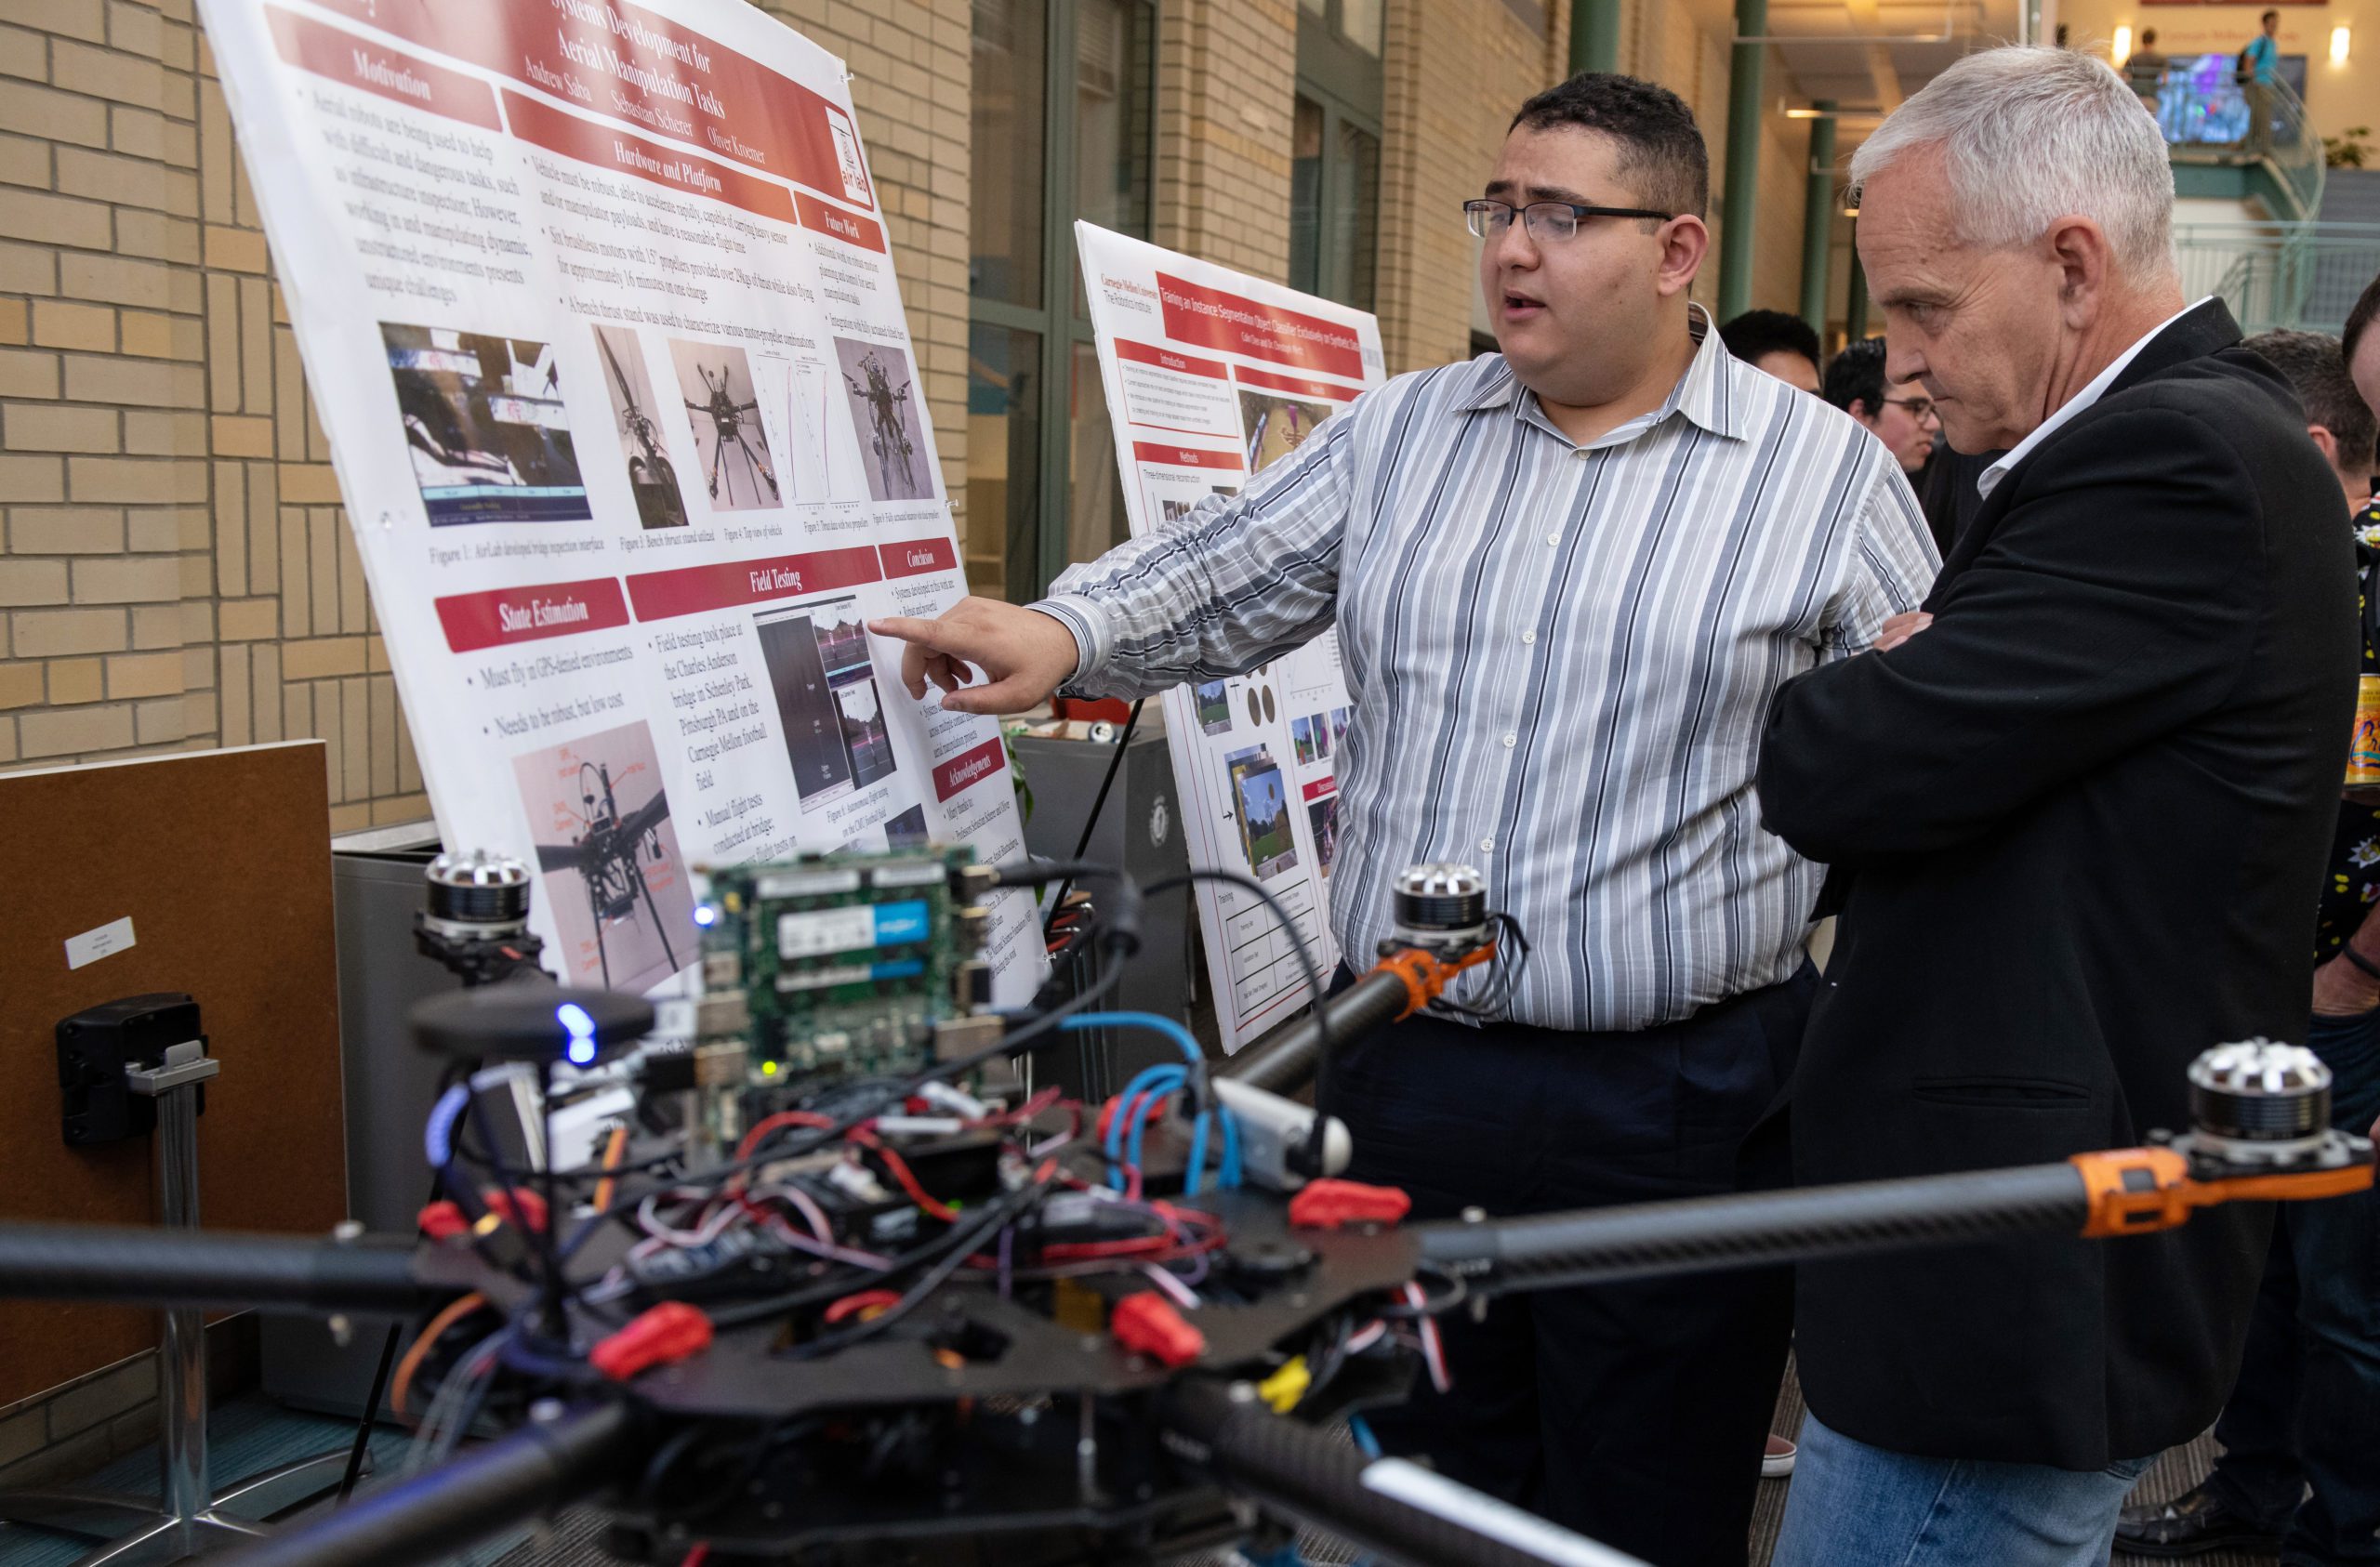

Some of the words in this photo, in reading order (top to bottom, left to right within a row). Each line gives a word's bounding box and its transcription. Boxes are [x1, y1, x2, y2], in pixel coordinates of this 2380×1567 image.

[605, 5, 693, 64] Development
[693, 44, 711, 73] for
[352, 48, 431, 100] Motivation
[558, 28, 604, 72] Aerial
[603, 46, 694, 106] Manipulation
[692, 82, 726, 119] Tasks
[525, 55, 563, 90] Andrew
[564, 73, 592, 101] Saba
[610, 89, 654, 125] Sebastian
[654, 108, 694, 137] Scherer
[707, 125, 732, 152] Oliver
[731, 135, 765, 165] Kroemer
[614, 140, 661, 176] Hardware
[663, 161, 681, 182] and
[682, 163, 722, 193] Platform
[842, 168, 854, 186] air
[854, 171, 866, 193] lab
[578, 172, 591, 191] be
[619, 183, 637, 202] able
[636, 189, 645, 204] to
[703, 209, 727, 228] capable
[727, 214, 734, 229] of
[825, 210, 845, 235] Future
[843, 218, 860, 239] Work
[599, 243, 627, 260] motors
[628, 245, 646, 264] with
[689, 260, 721, 280] provided
[721, 269, 734, 283] over
[623, 269, 635, 288] 16
[623, 306, 644, 323] stand
[643, 311, 660, 325] was
[1160, 287, 1183, 310] Training
[1183, 297, 1192, 310] an
[1192, 297, 1219, 317] Instance
[1218, 304, 1254, 325] Segmentation
[1159, 352, 1186, 369] Introduction
[1179, 451, 1199, 464] Methods
[619, 536, 640, 554] Figure
[723, 527, 738, 544] Figure
[743, 526, 753, 542] Top
[751, 526, 763, 538] view
[768, 523, 783, 536] vehicle
[906, 548, 935, 569] Conclusion
[749, 569, 772, 593] Field
[772, 566, 803, 591] Testing
[894, 586, 912, 602] Systems
[911, 580, 931, 599] developed
[498, 601, 533, 632] State
[532, 596, 588, 627] Estimation
[903, 604, 917, 617] Robust
[921, 599, 938, 618] powerful
[654, 632, 678, 653] Field
[677, 628, 705, 649] testing
[703, 624, 720, 643] took
[719, 623, 736, 645] place
[735, 622, 744, 636] at
[480, 666, 511, 689] Must
[511, 661, 527, 688] fly
[527, 659, 537, 680] in
[581, 646, 634, 668] environments
[664, 663, 678, 681] the
[676, 656, 707, 678] Charles
[707, 652, 738, 672] Anderson
[670, 688, 697, 710] bridge
[696, 685, 707, 703] in
[704, 678, 736, 697] Schenley
[494, 713, 530, 738] Needs
[529, 714, 539, 730] to
[538, 706, 552, 727] be
[575, 697, 591, 718] but
[589, 694, 606, 713] low
[606, 691, 625, 708] cost
[679, 710, 718, 737] Pittsburgh
[716, 708, 729, 726] PA
[727, 703, 741, 722] and
[740, 705, 749, 718] on
[748, 698, 760, 716] the
[687, 738, 721, 763] Carnegie
[718, 732, 744, 754] Mellon
[743, 721, 768, 745] football
[696, 769, 714, 791] field
[949, 754, 992, 788] Acknowledgements
[705, 802, 732, 828] Manual
[731, 797, 748, 819] flight
[747, 794, 763, 810] tests
[826, 809, 842, 824] Figure
[855, 817, 866, 833] CMU
[946, 806, 959, 822] Many
[713, 825, 746, 856] conducted
[774, 838, 789, 855] tests
[1218, 891, 1235, 904] Training
